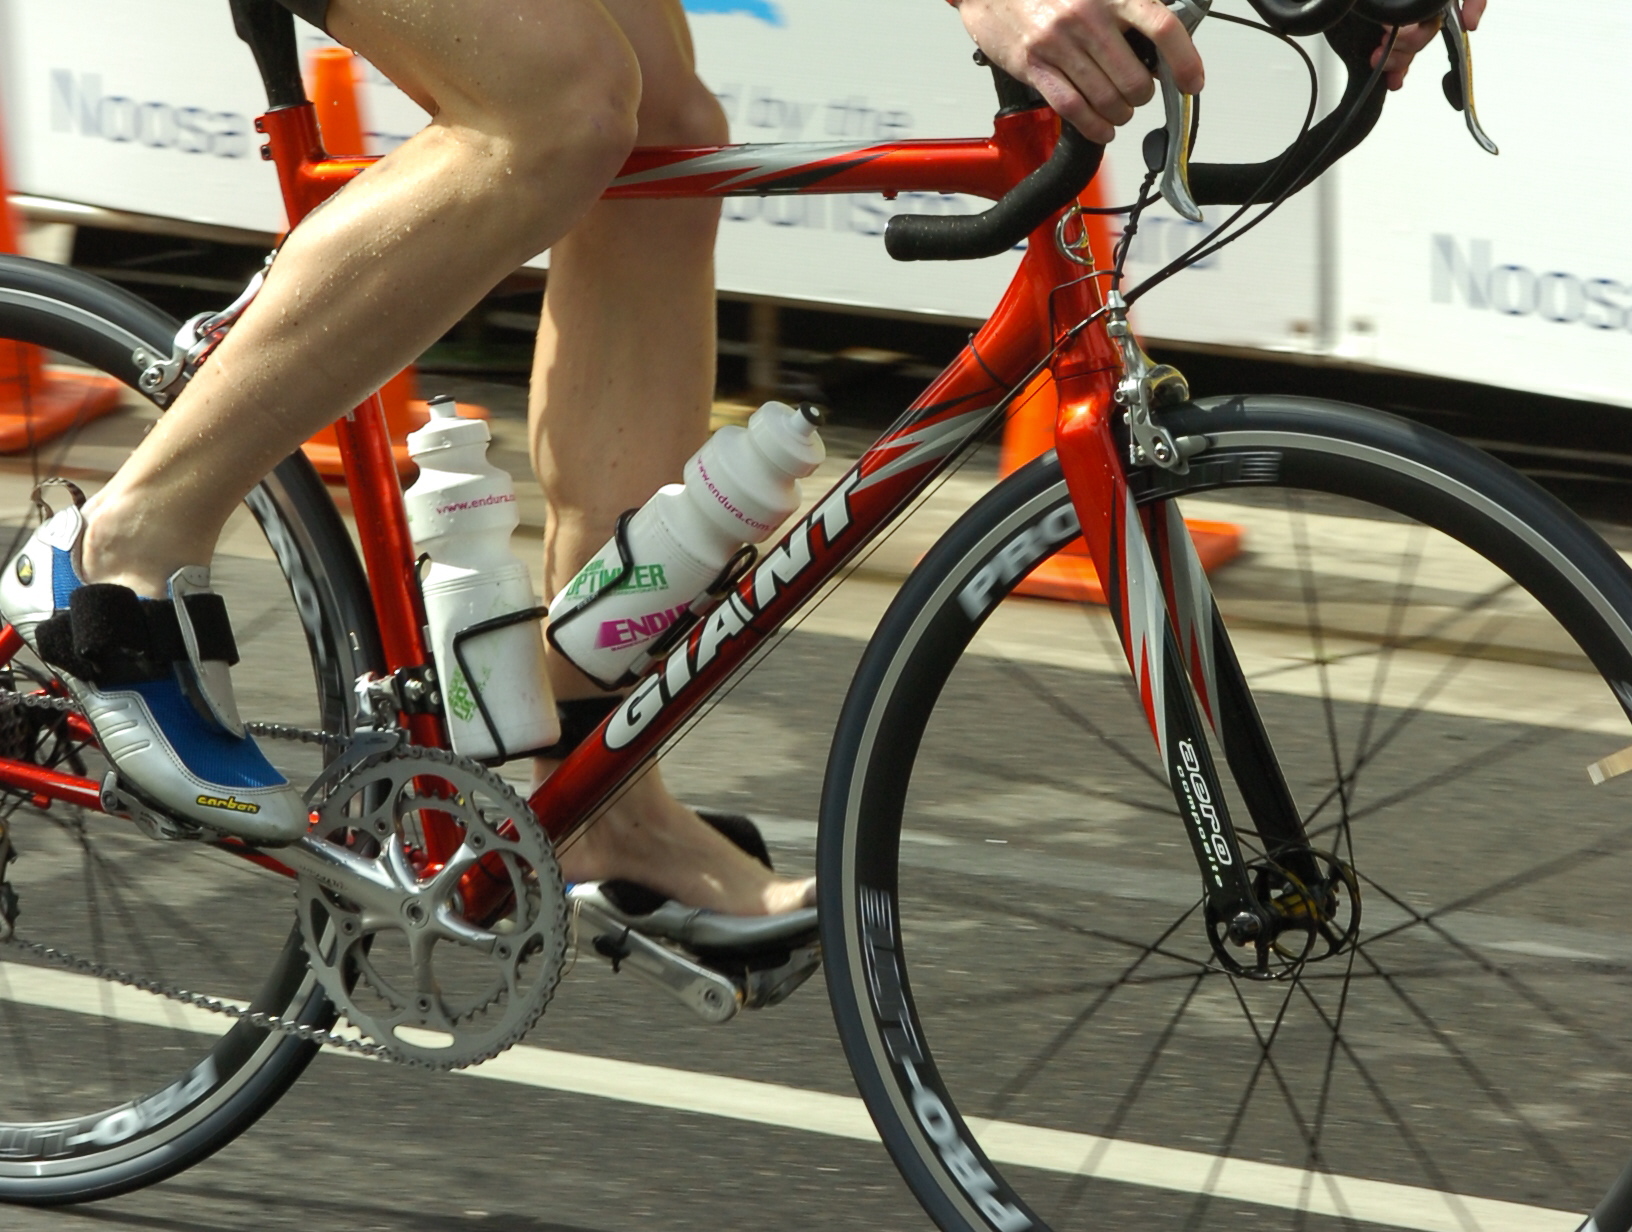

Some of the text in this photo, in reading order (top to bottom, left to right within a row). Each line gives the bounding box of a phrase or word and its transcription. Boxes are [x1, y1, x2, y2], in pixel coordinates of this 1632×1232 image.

[51, 68, 247, 158] Noosa
[1430, 232, 1632, 335] Noos
[605, 469, 859, 750] GIANT
[196, 795, 260, 814] carbon
